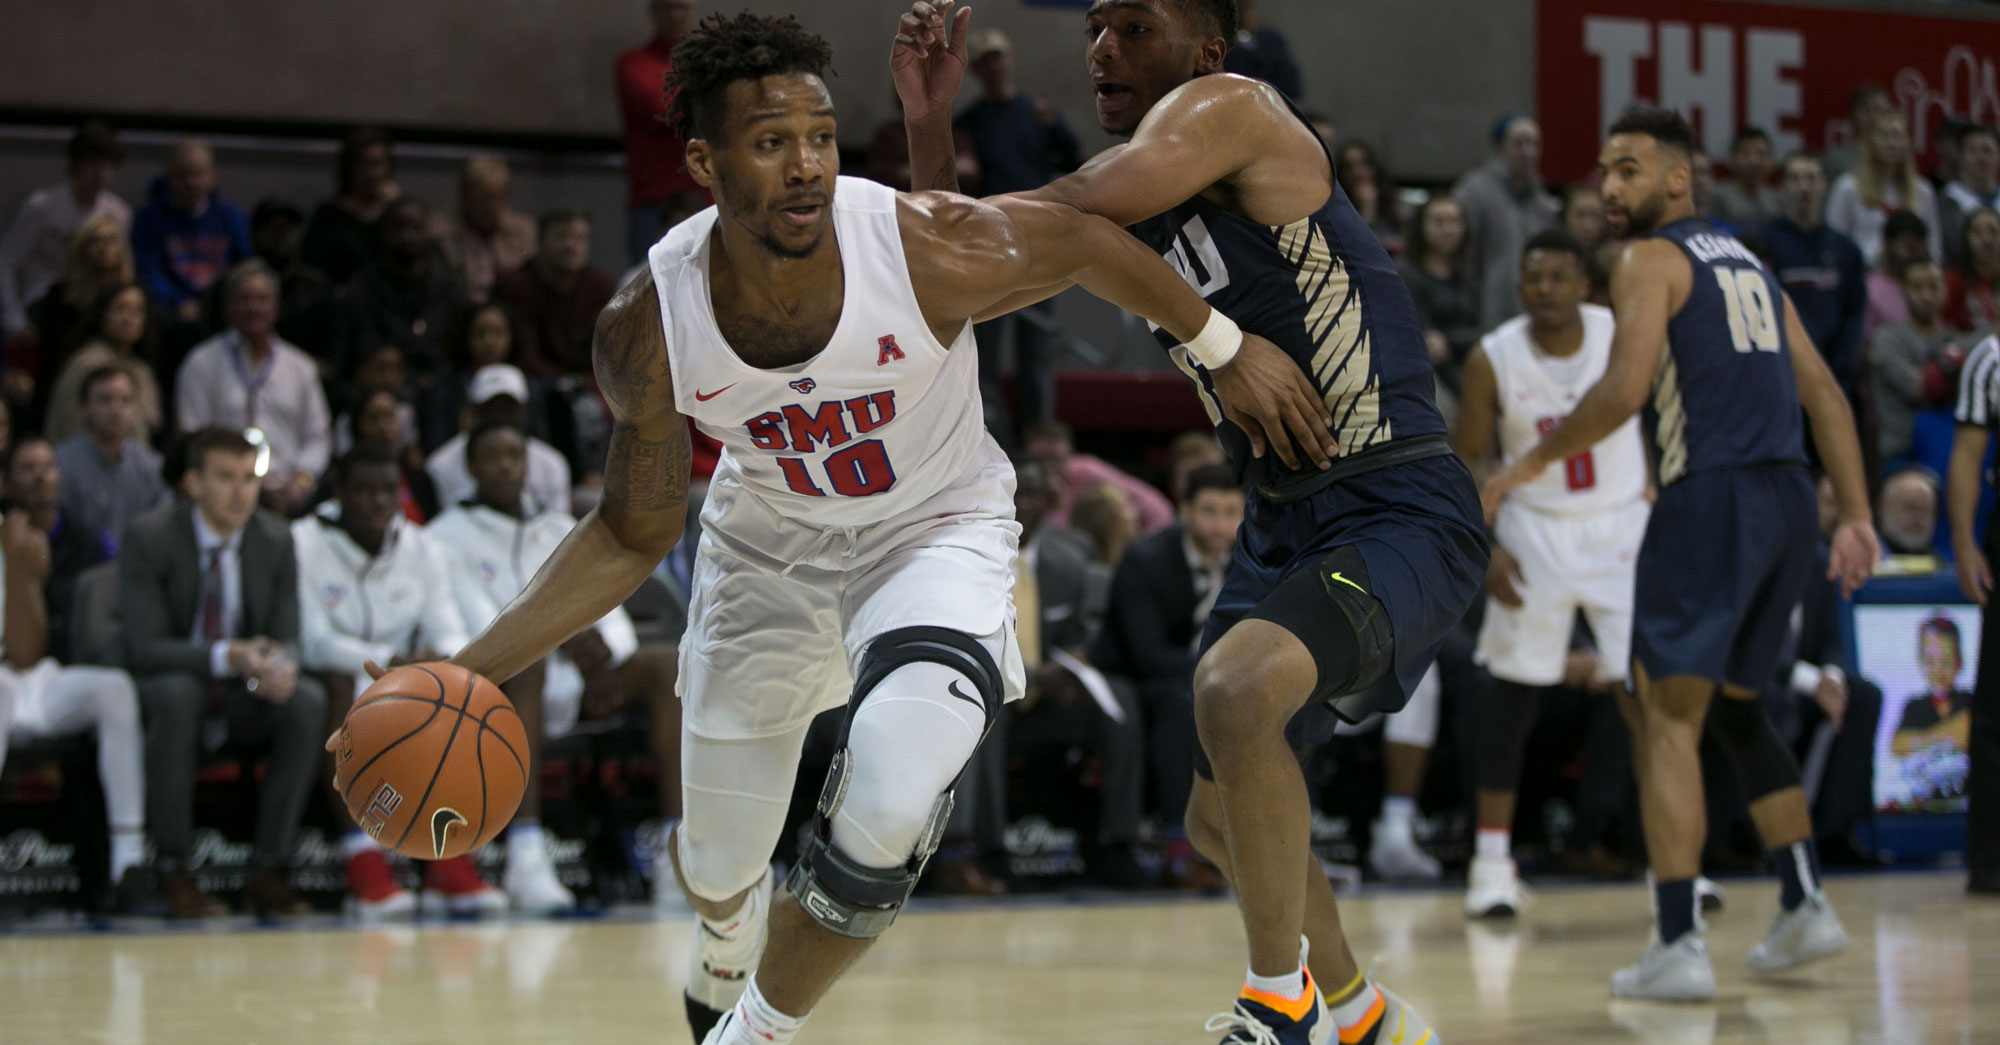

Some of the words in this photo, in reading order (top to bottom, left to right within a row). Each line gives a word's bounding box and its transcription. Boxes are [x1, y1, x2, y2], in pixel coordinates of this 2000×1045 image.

[1584, 14, 1805, 165] THE
[1713, 265, 1780, 353] 10
[877, 334, 905, 366] A
[742, 389, 896, 453] SMU
[775, 438, 897, 497] 10
